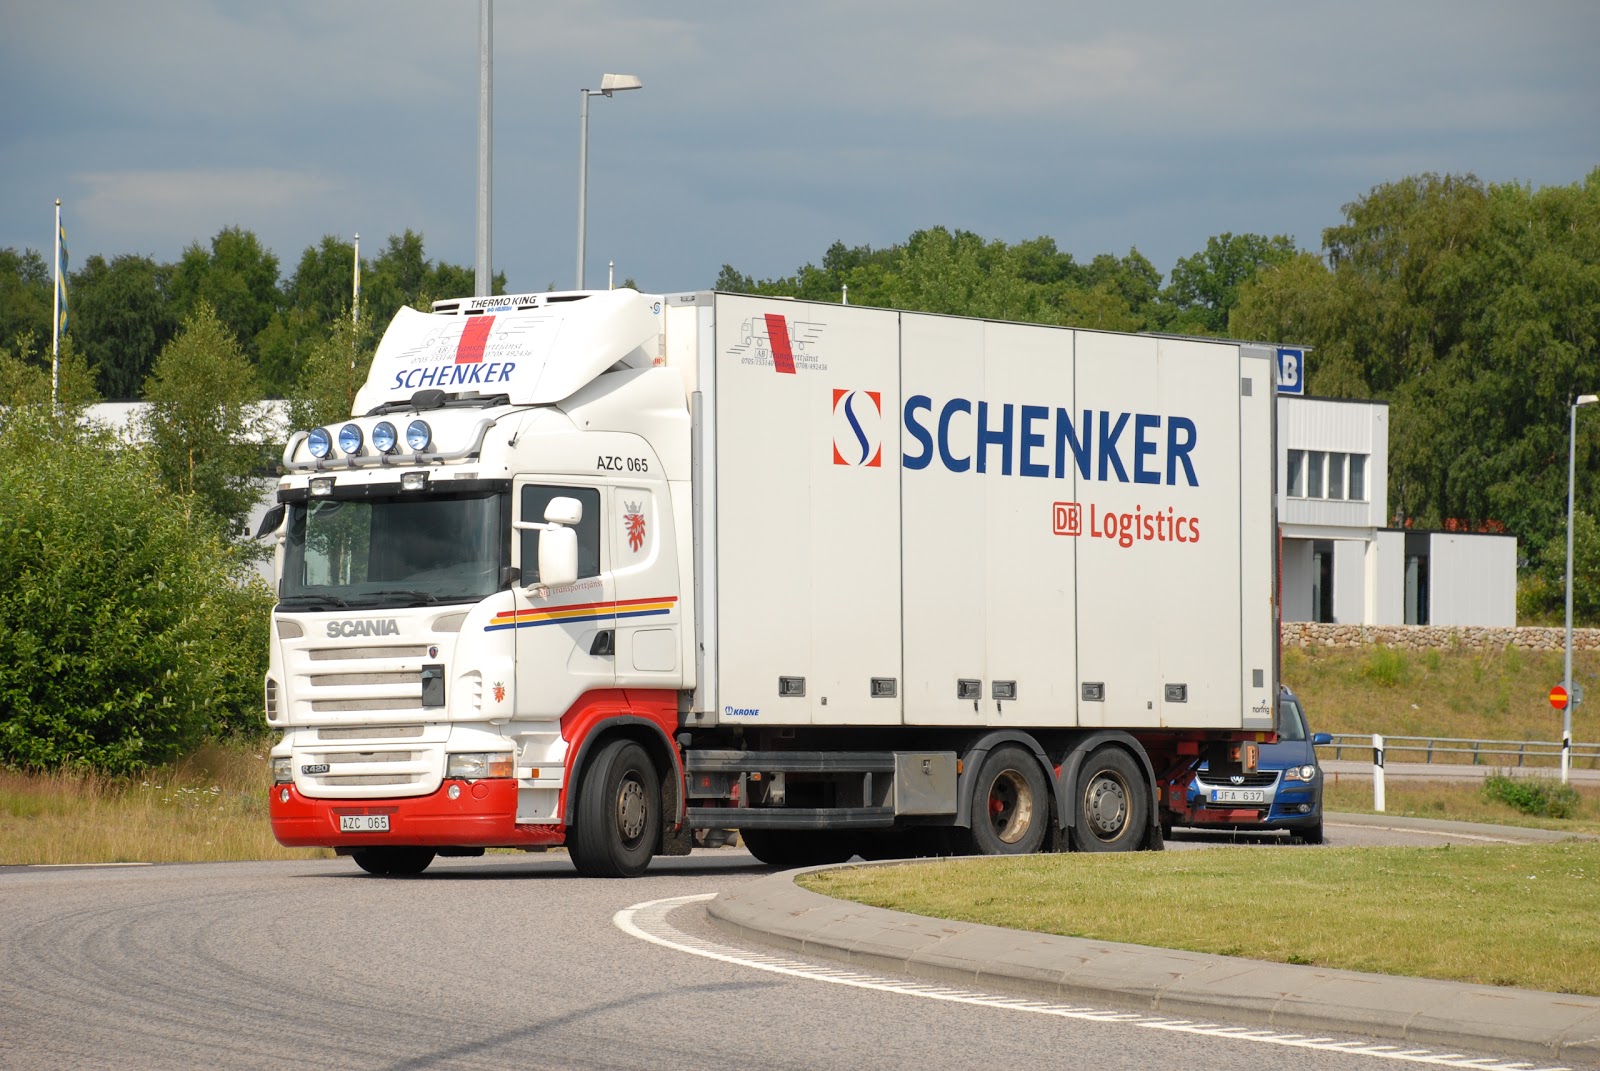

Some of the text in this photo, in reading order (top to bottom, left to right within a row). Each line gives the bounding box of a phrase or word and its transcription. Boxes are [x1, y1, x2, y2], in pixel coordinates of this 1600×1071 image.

[471, 296, 537, 308] THERMO KING
[390, 362, 516, 390] SCHENKER
[902, 395, 1199, 487] SCHENKER
[596, 456, 649, 472] AZC 065
[1055, 503, 1200, 548] DB Logistics
[326, 619, 400, 638] SCANIA
[733, 708, 760, 716] KRONE
[1218, 791, 1261, 801] JFA 637
[343, 817, 387, 829] AZC 065
